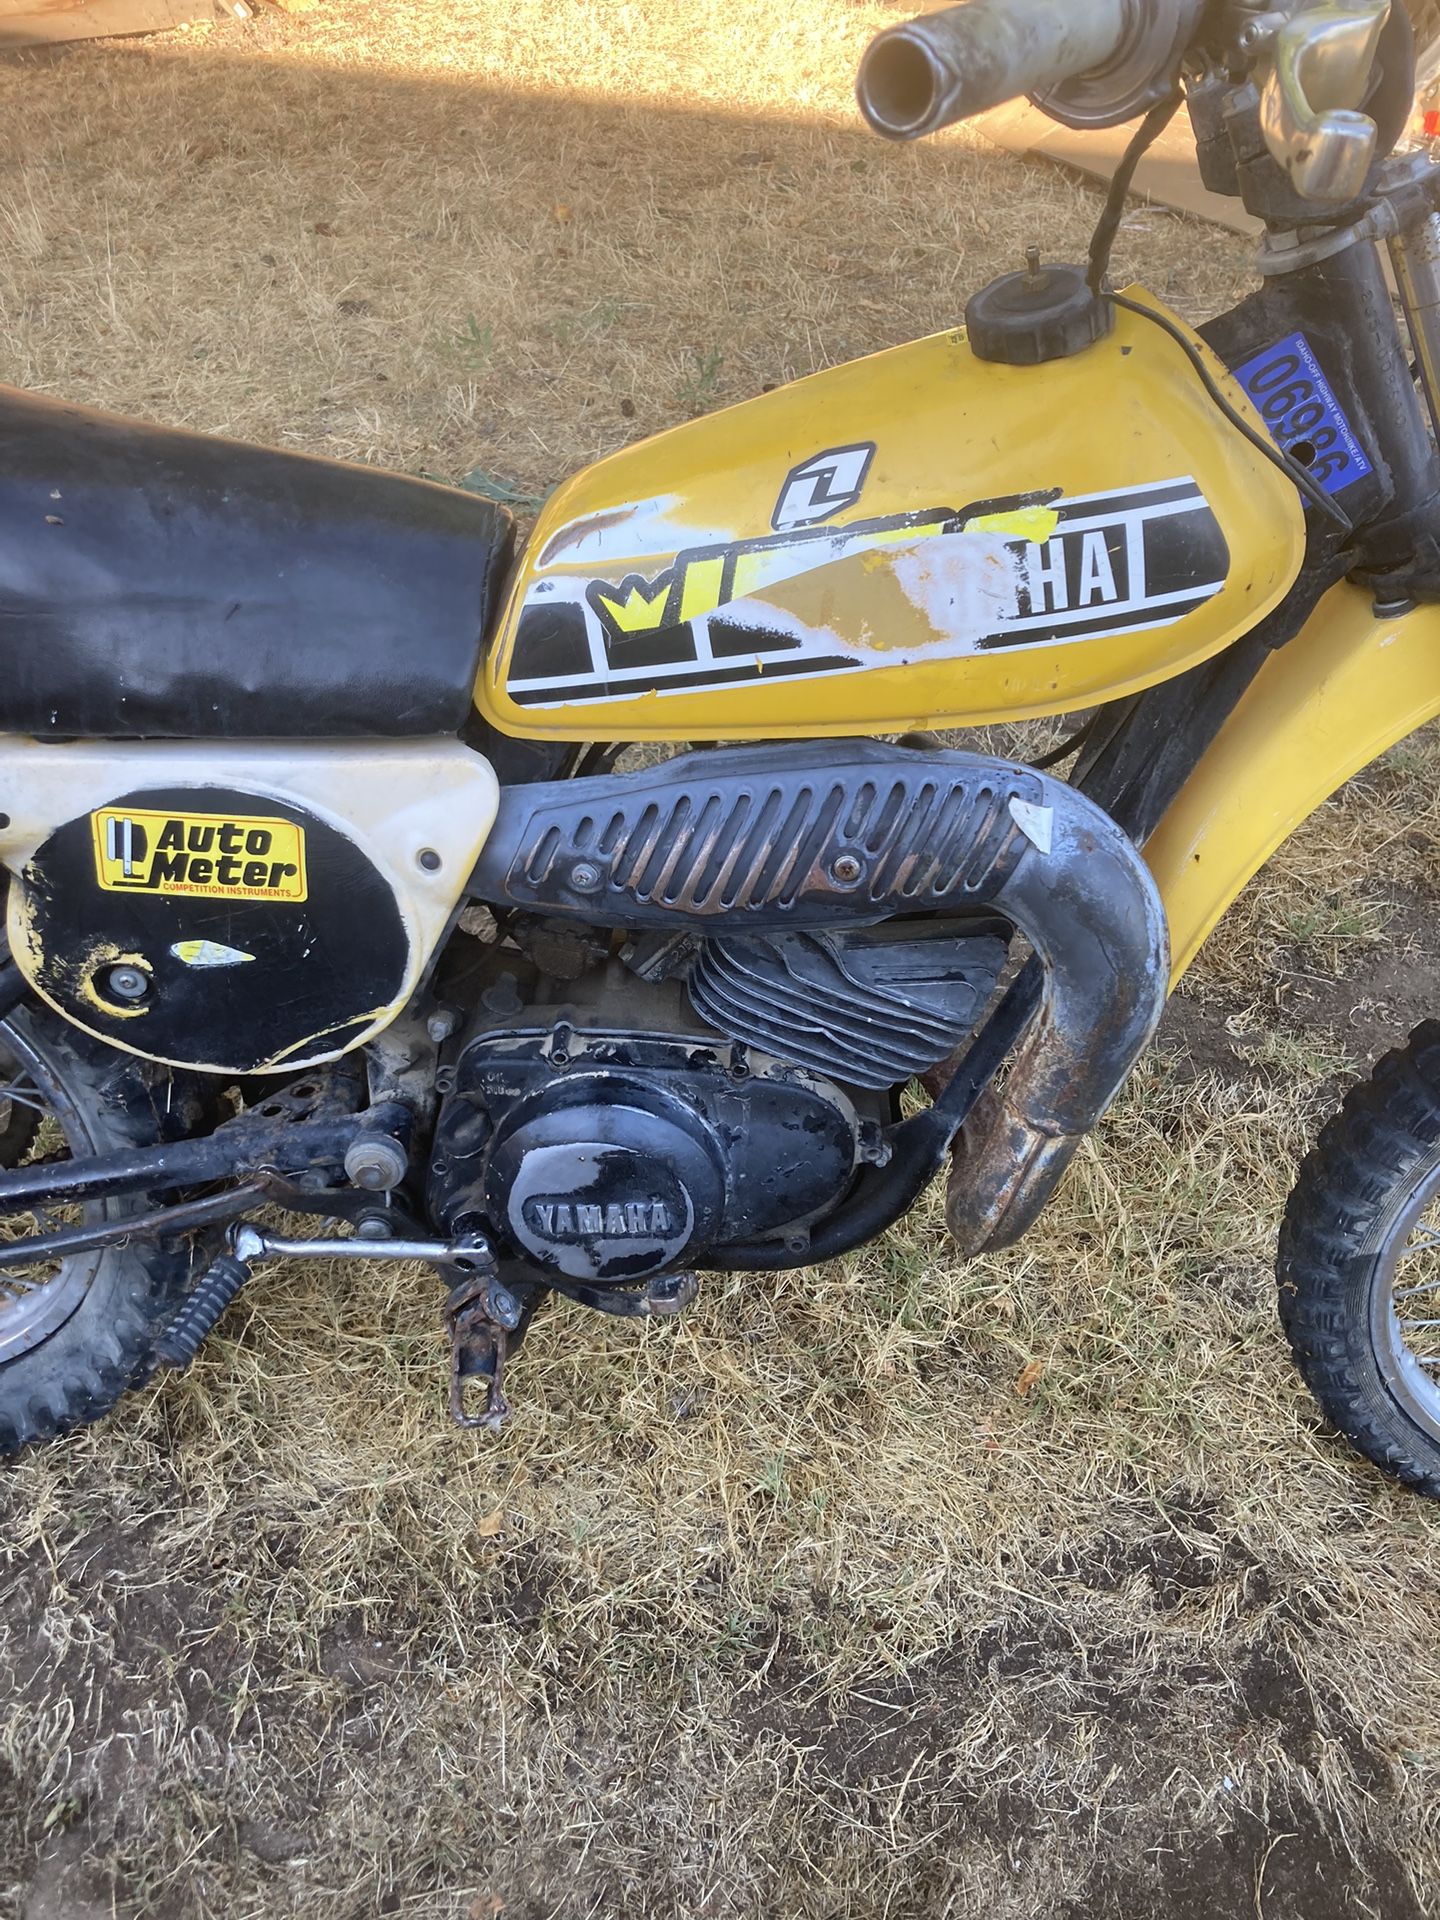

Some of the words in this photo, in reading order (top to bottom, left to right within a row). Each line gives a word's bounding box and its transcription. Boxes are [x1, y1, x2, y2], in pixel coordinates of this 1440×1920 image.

[1315, 376, 1338, 413] HIGHWAY
[156, 819, 273, 856] Auto
[149, 850, 298, 889] Meter
[163, 882, 225, 895] COMPETITION
[226, 886, 292, 898] INSTRUMENTS
[535, 1201, 671, 1235] YAMAHA
